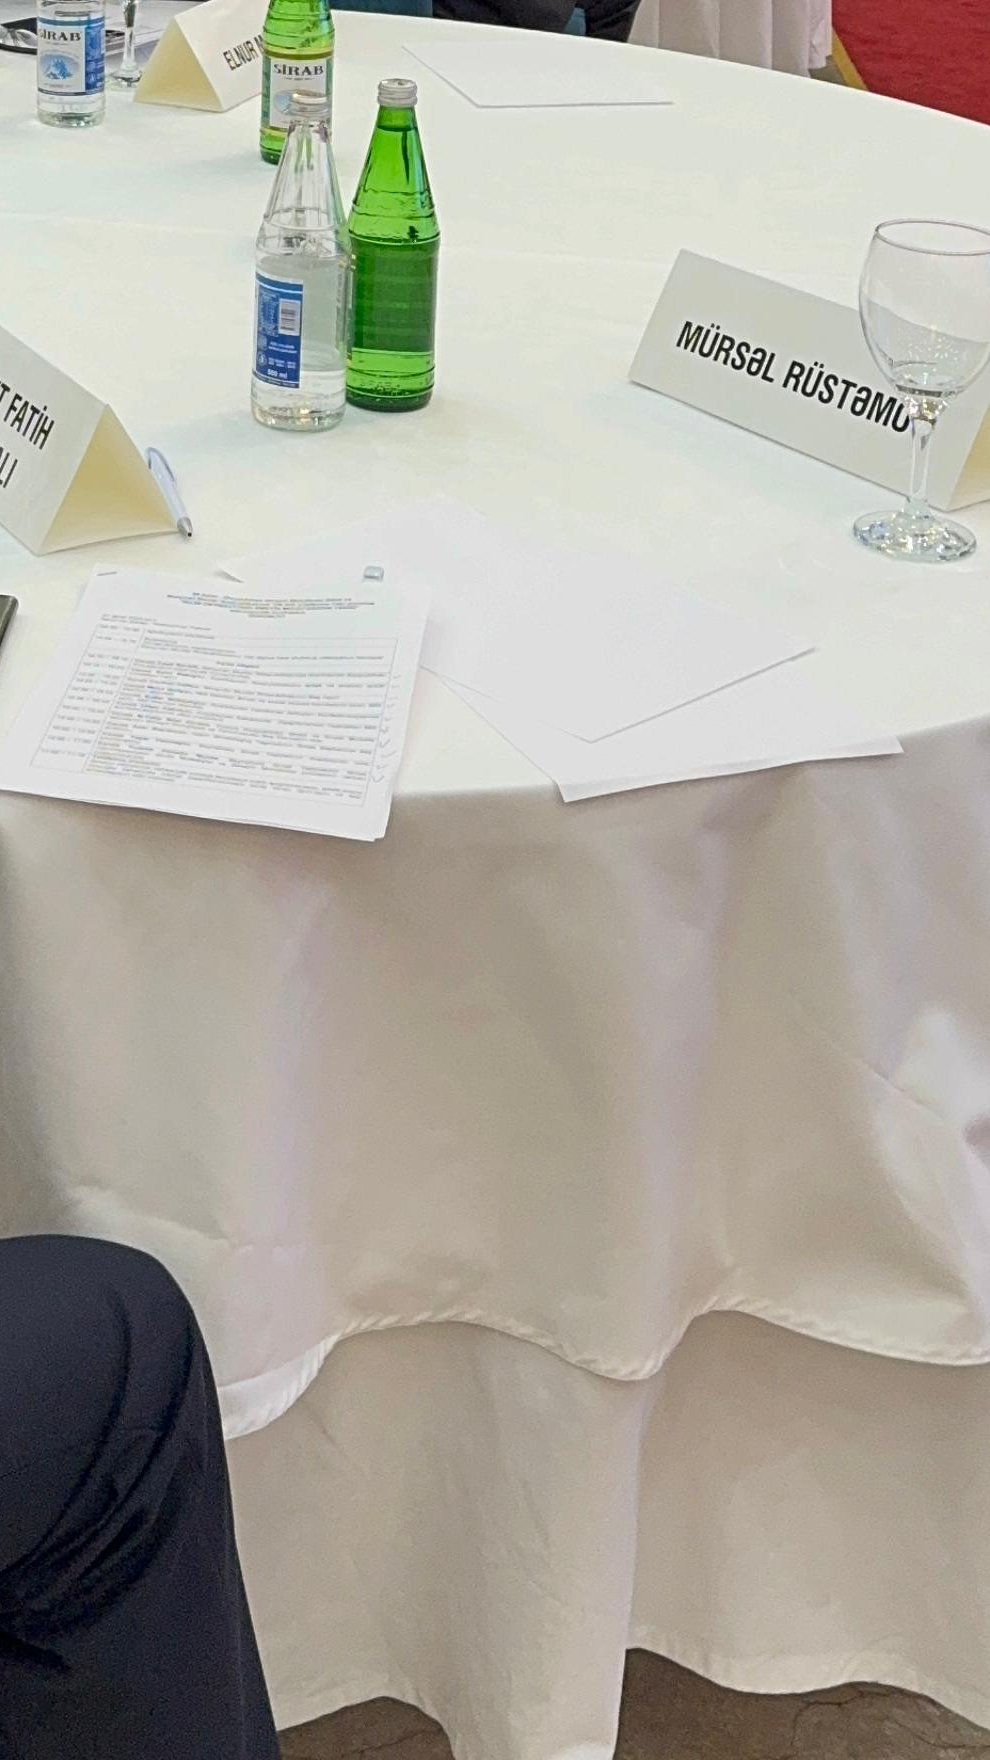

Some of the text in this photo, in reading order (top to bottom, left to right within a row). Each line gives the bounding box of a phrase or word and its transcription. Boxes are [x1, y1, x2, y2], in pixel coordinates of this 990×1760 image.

[223, 39, 259, 71] ELNUR
[675, 320, 776, 384] MÜRSƏL
[3, 392, 55, 450] FATİH
